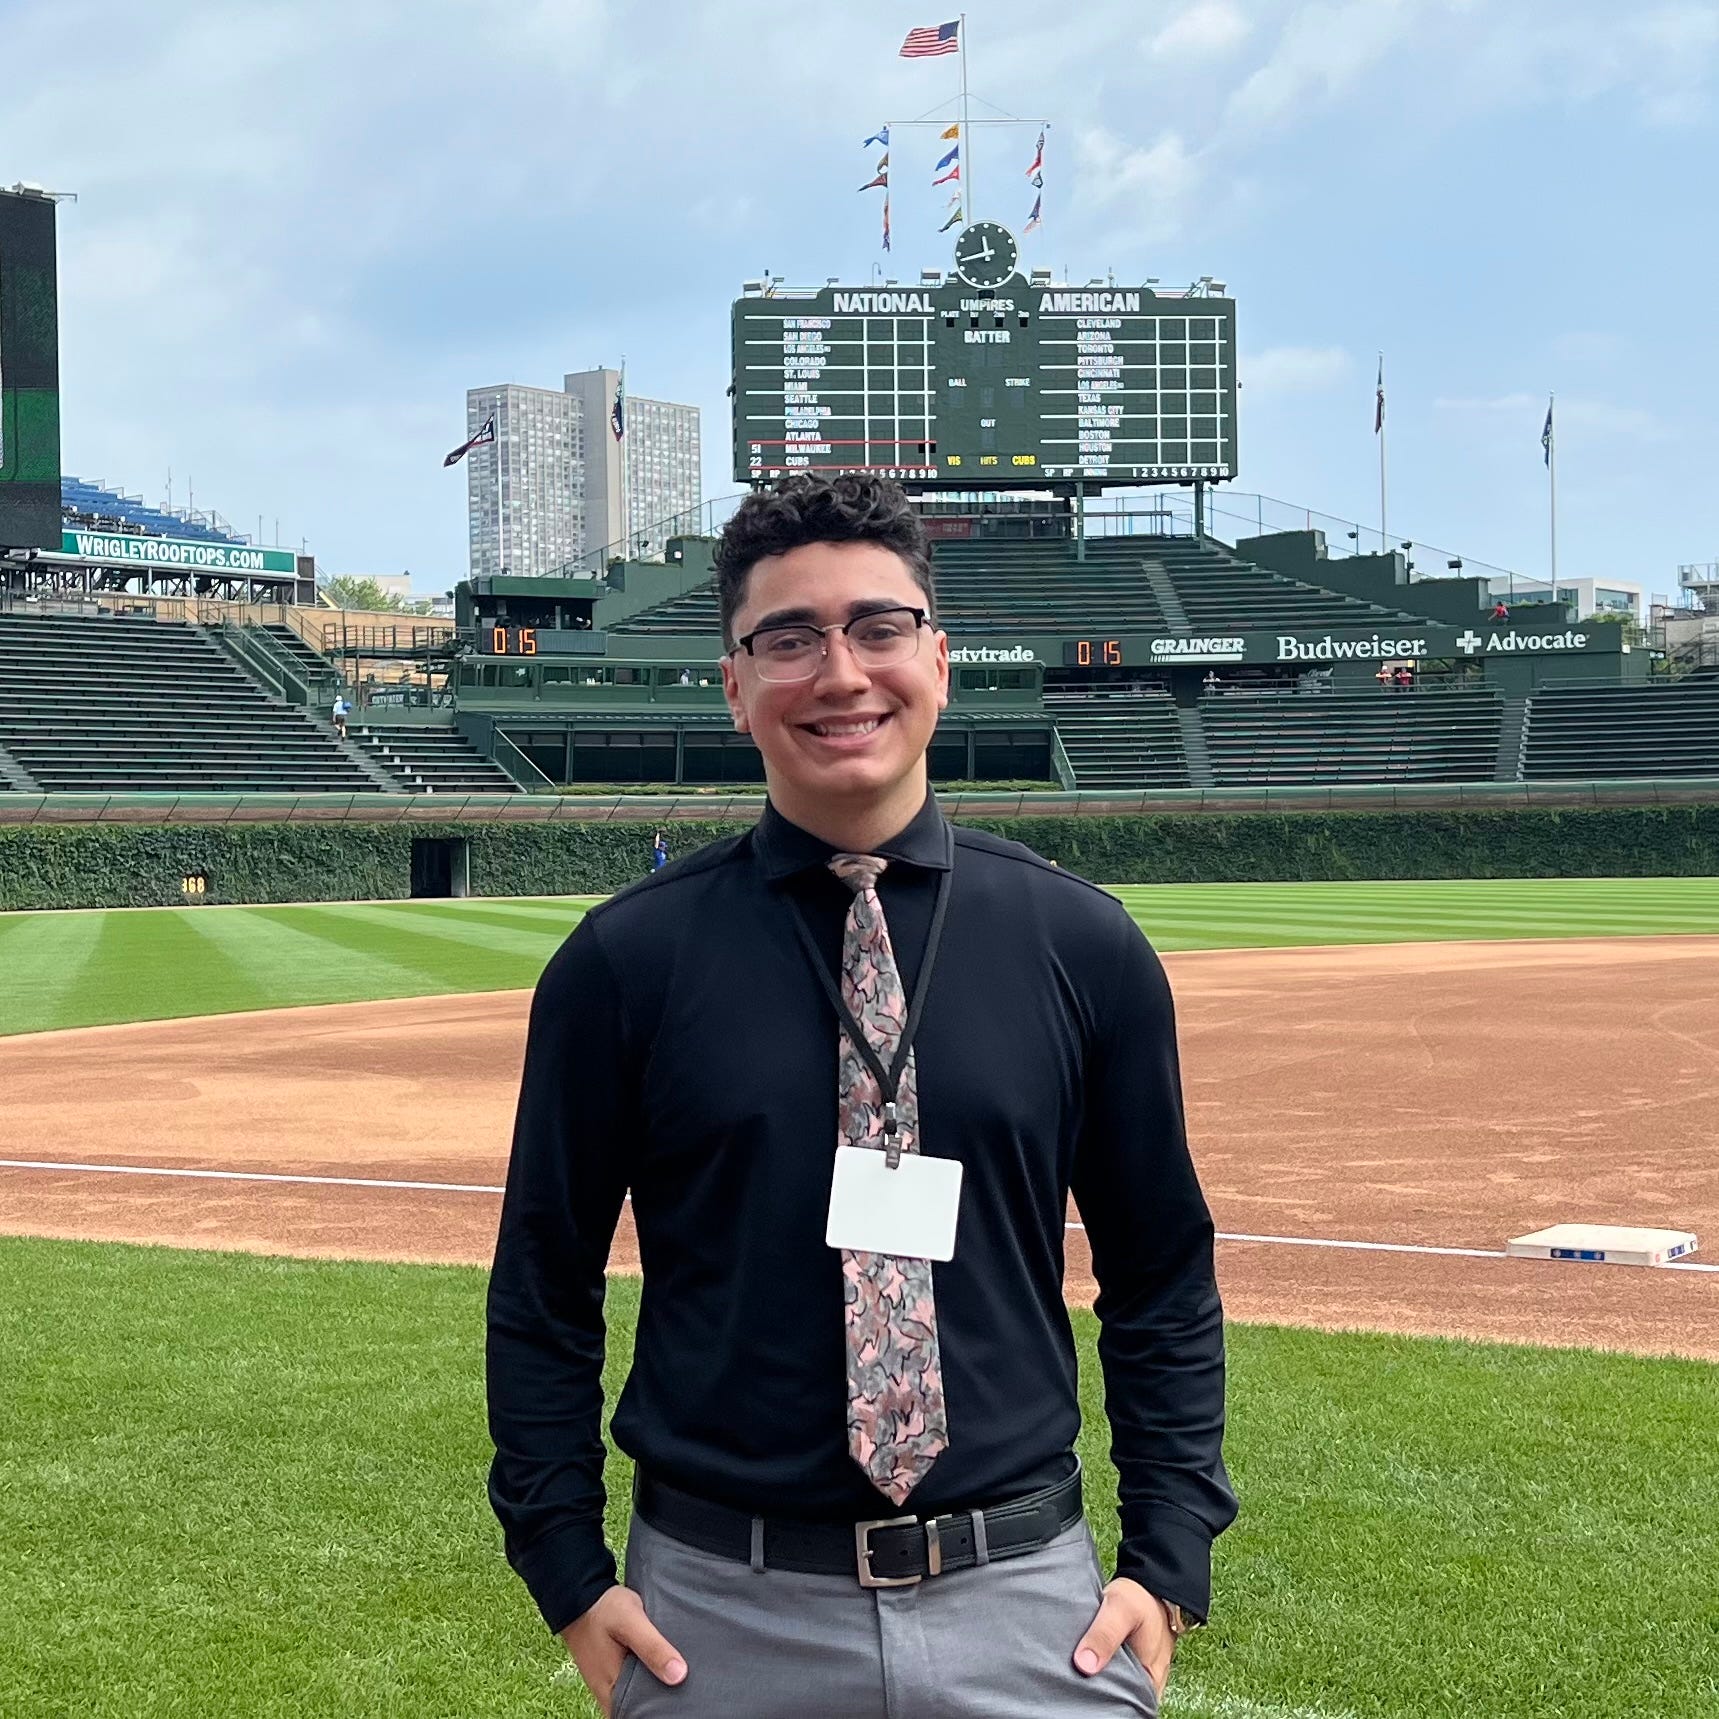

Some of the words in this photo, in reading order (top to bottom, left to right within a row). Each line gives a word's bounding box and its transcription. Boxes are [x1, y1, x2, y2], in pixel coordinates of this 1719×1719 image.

[834, 293, 935, 312] NATIONAL
[960, 299, 1015, 311] UMPIRES
[1039, 293, 1140, 312] AMERICAN
[783, 320, 796, 328] SAN
[797, 320, 831, 328] FRANCISCO
[1076, 319, 1121, 328] CLEVELAND
[783, 332, 798, 341] SAN
[800, 332, 822, 341] DIEGO
[964, 330, 1011, 343] BATTER
[1077, 332, 1111, 340] ARIZONA
[784, 345, 795, 353] LOS
[1077, 344, 1114, 353] TORONTO
[784, 357, 826, 366] COLORADO
[1077, 356, 1124, 365] PITTSBURGH
[784, 370, 796, 379] ST.
[797, 370, 820, 379] LOUIS
[1078, 369, 1120, 378] CINCINNATI
[784, 382, 808, 391] MIAMI
[948, 379, 967, 387] BALL
[1005, 378, 1031, 386] STRIKE
[1078, 380, 1090, 389] LOS
[784, 395, 818, 403] SEATTLE
[1078, 394, 1101, 403] TEXAS
[785, 407, 831, 416] PHILADELPHIA
[1078, 406, 1106, 415] KANSAS
[1107, 406, 1124, 415] CITY
[785, 419, 819, 428] CHICAGO
[980, 419, 996, 427] OUT
[1079, 418, 1120, 427] BALTIMORE
[785, 432, 821, 441] ATLANTA
[1079, 430, 1110, 439] BOSTON
[785, 444, 831, 453] MILWAUKEE
[1079, 443, 1112, 452] HOUSTON
[750, 457, 762, 466] 22
[786, 456, 809, 466] CUBS
[947, 456, 961, 465] VIS
[980, 456, 998, 465] HITS
[1012, 455, 1036, 465] CUBS
[1079, 455, 1109, 464] DETROIT
[751, 470, 761, 478] SP
[880, 469, 885, 478] 5
[889, 469, 896, 478] 6
[900, 469, 906, 478] 7
[909, 469, 916, 478] 8
[919, 469, 926, 478] 9
[928, 469, 937, 478] 10
[1045, 469, 1055, 477] SP
[1132, 469, 1137, 477] 1
[1141, 469, 1148, 477] 2
[1151, 469, 1159, 477] 3
[1161, 469, 1168, 477] 4
[1171, 469, 1177, 477] 5
[1180, 469, 1187, 477] 6
[1191, 469, 1197, 477] 7
[1200, 469, 1207, 477] 8
[1210, 469, 1217, 477] 9
[1220, 469, 1229, 477] 10
[76, 534, 264, 569] WRIGLEYROOFTOPS.COM
[1151, 637, 1244, 654] GRAINGER
[1486, 631, 1586, 652] Advocate
[1276, 634, 1425, 660] Budweiser
